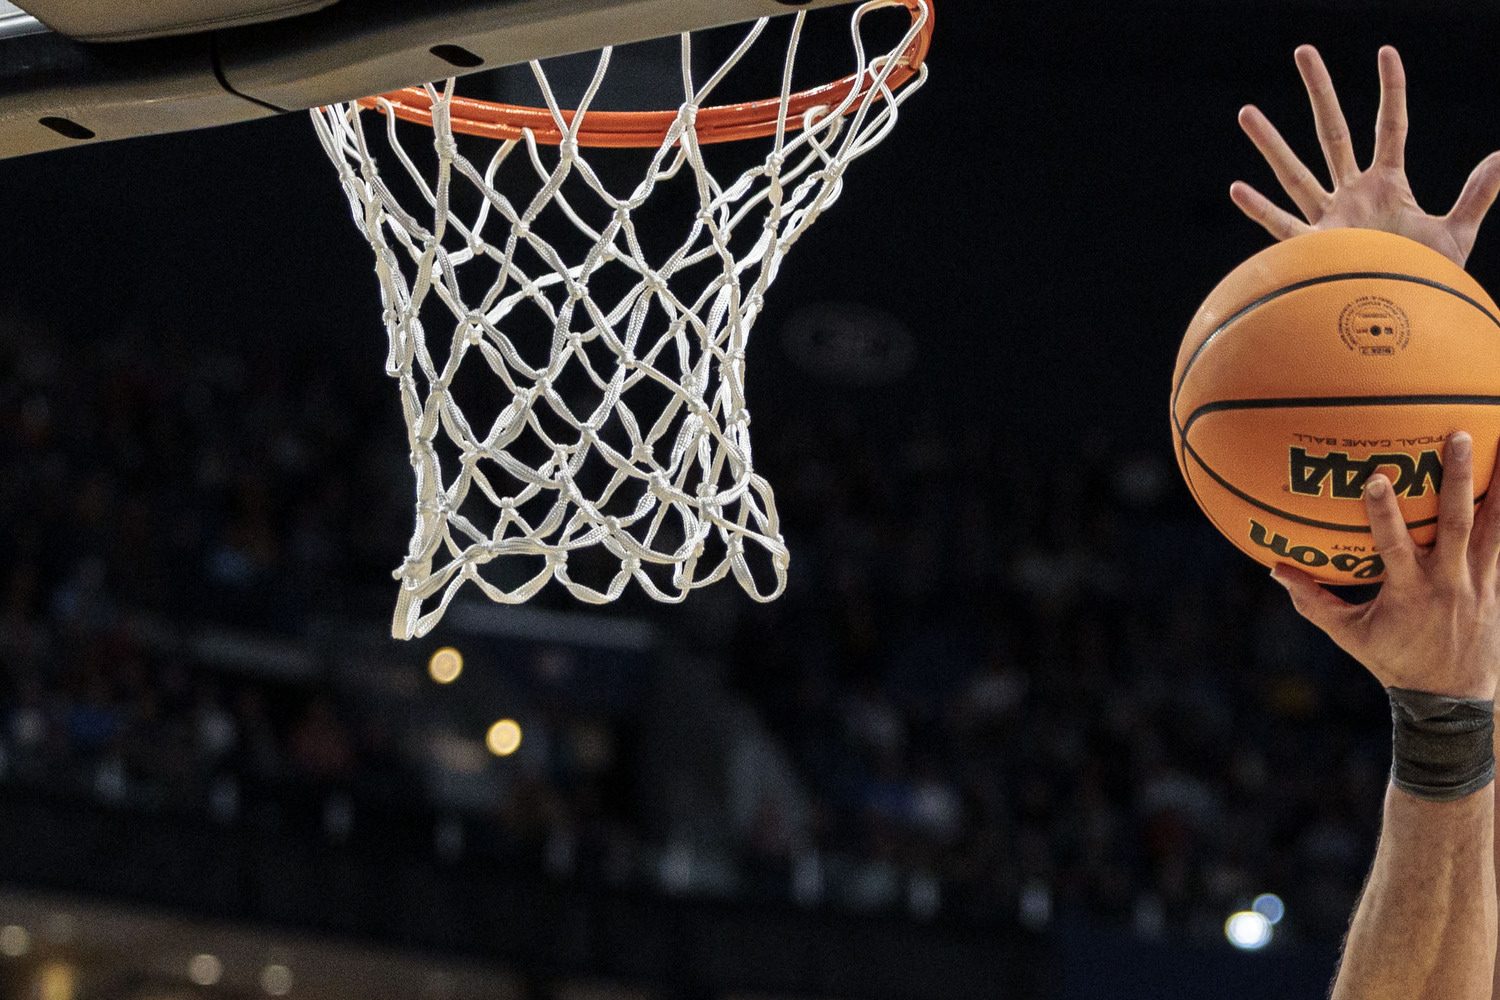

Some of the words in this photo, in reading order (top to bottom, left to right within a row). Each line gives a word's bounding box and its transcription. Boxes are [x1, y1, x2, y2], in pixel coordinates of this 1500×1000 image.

[1293, 433, 1338, 447] BALL
[1342, 439, 1391, 447] GAME
[1396, 434, 1449, 447] FICIAL
[1289, 445, 1443, 500] NCAA
